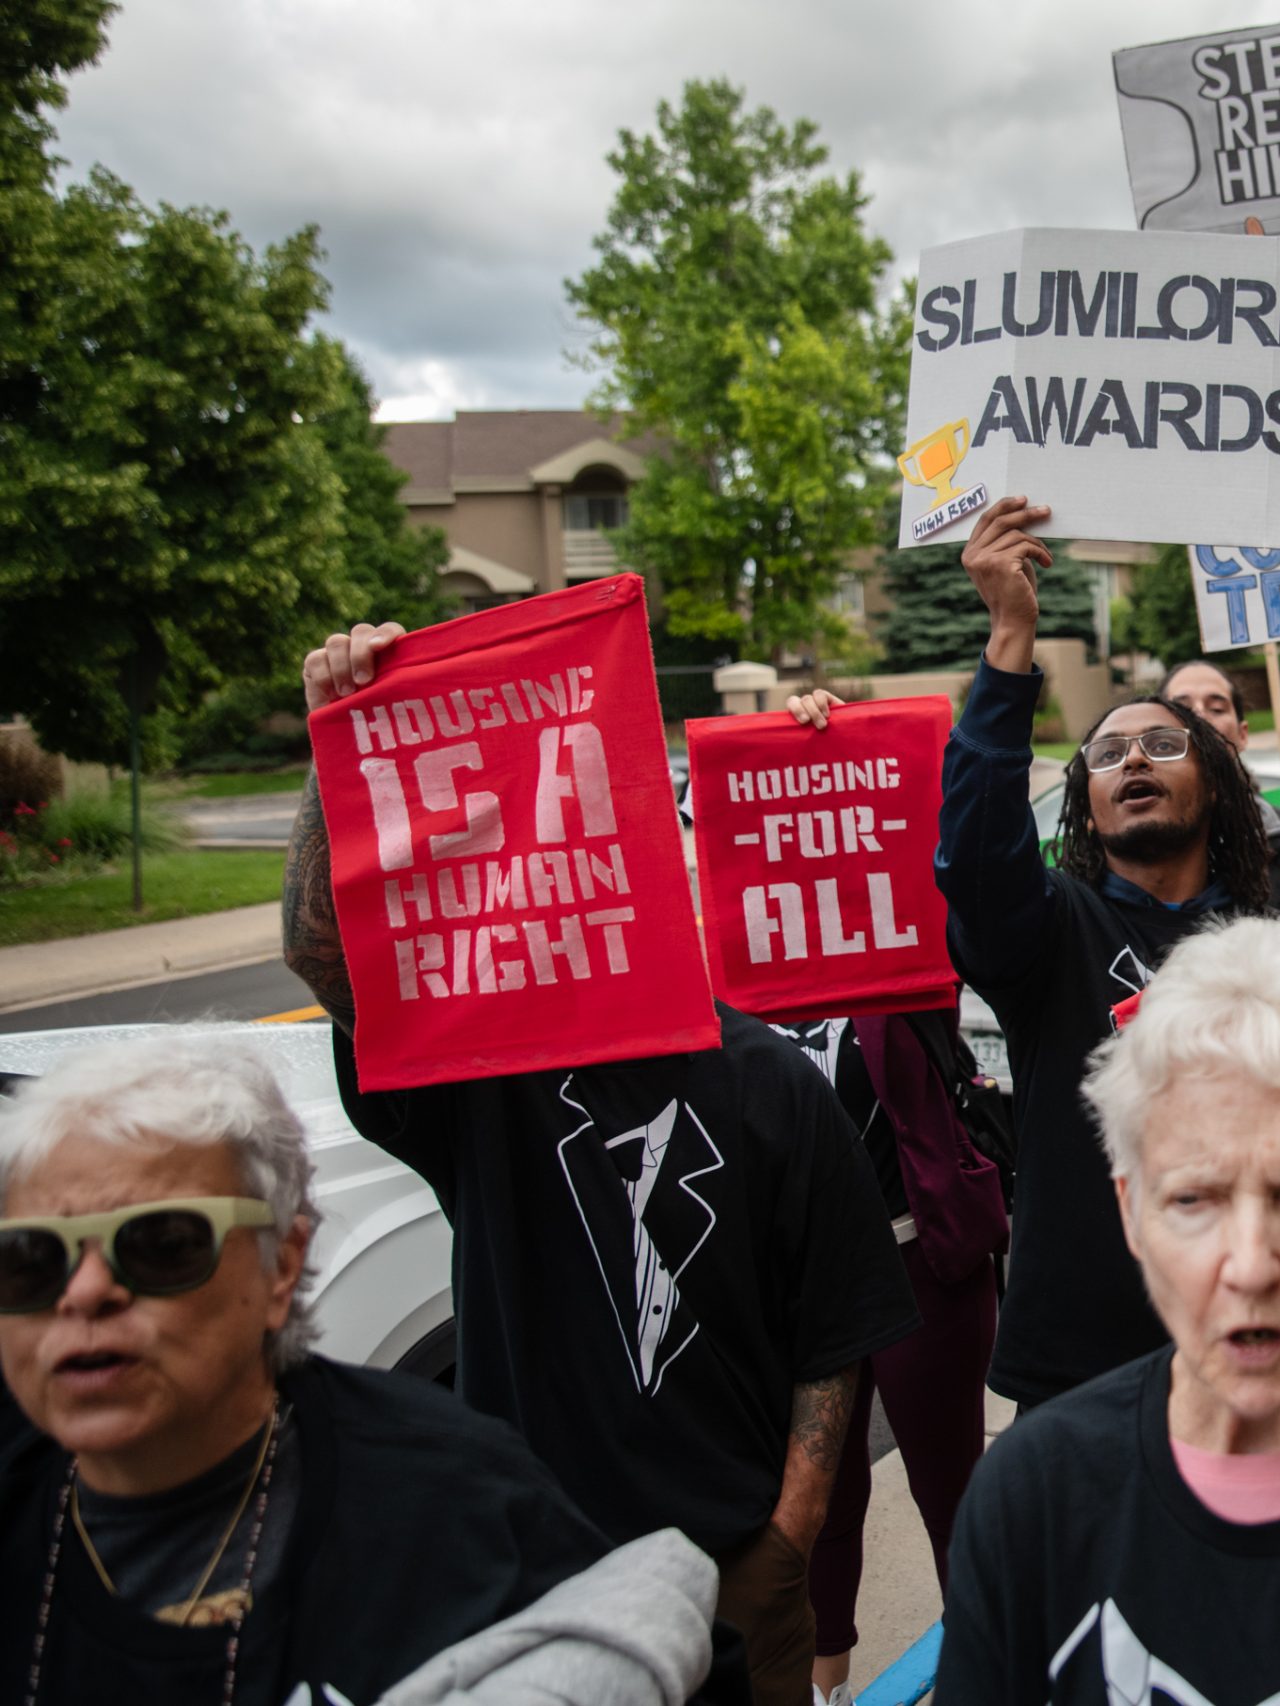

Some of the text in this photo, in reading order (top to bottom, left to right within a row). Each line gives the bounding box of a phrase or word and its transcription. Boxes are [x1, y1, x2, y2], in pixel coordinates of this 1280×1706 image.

[914, 486, 985, 538] HIGH RENT
[350, 664, 597, 756] HOUSING
[359, 721, 618, 874] IS A
[727, 757, 903, 804] HOUSING
[384, 844, 632, 929] HUMAN
[742, 872, 919, 965] ALL
[394, 906, 637, 1002] RIGHT
